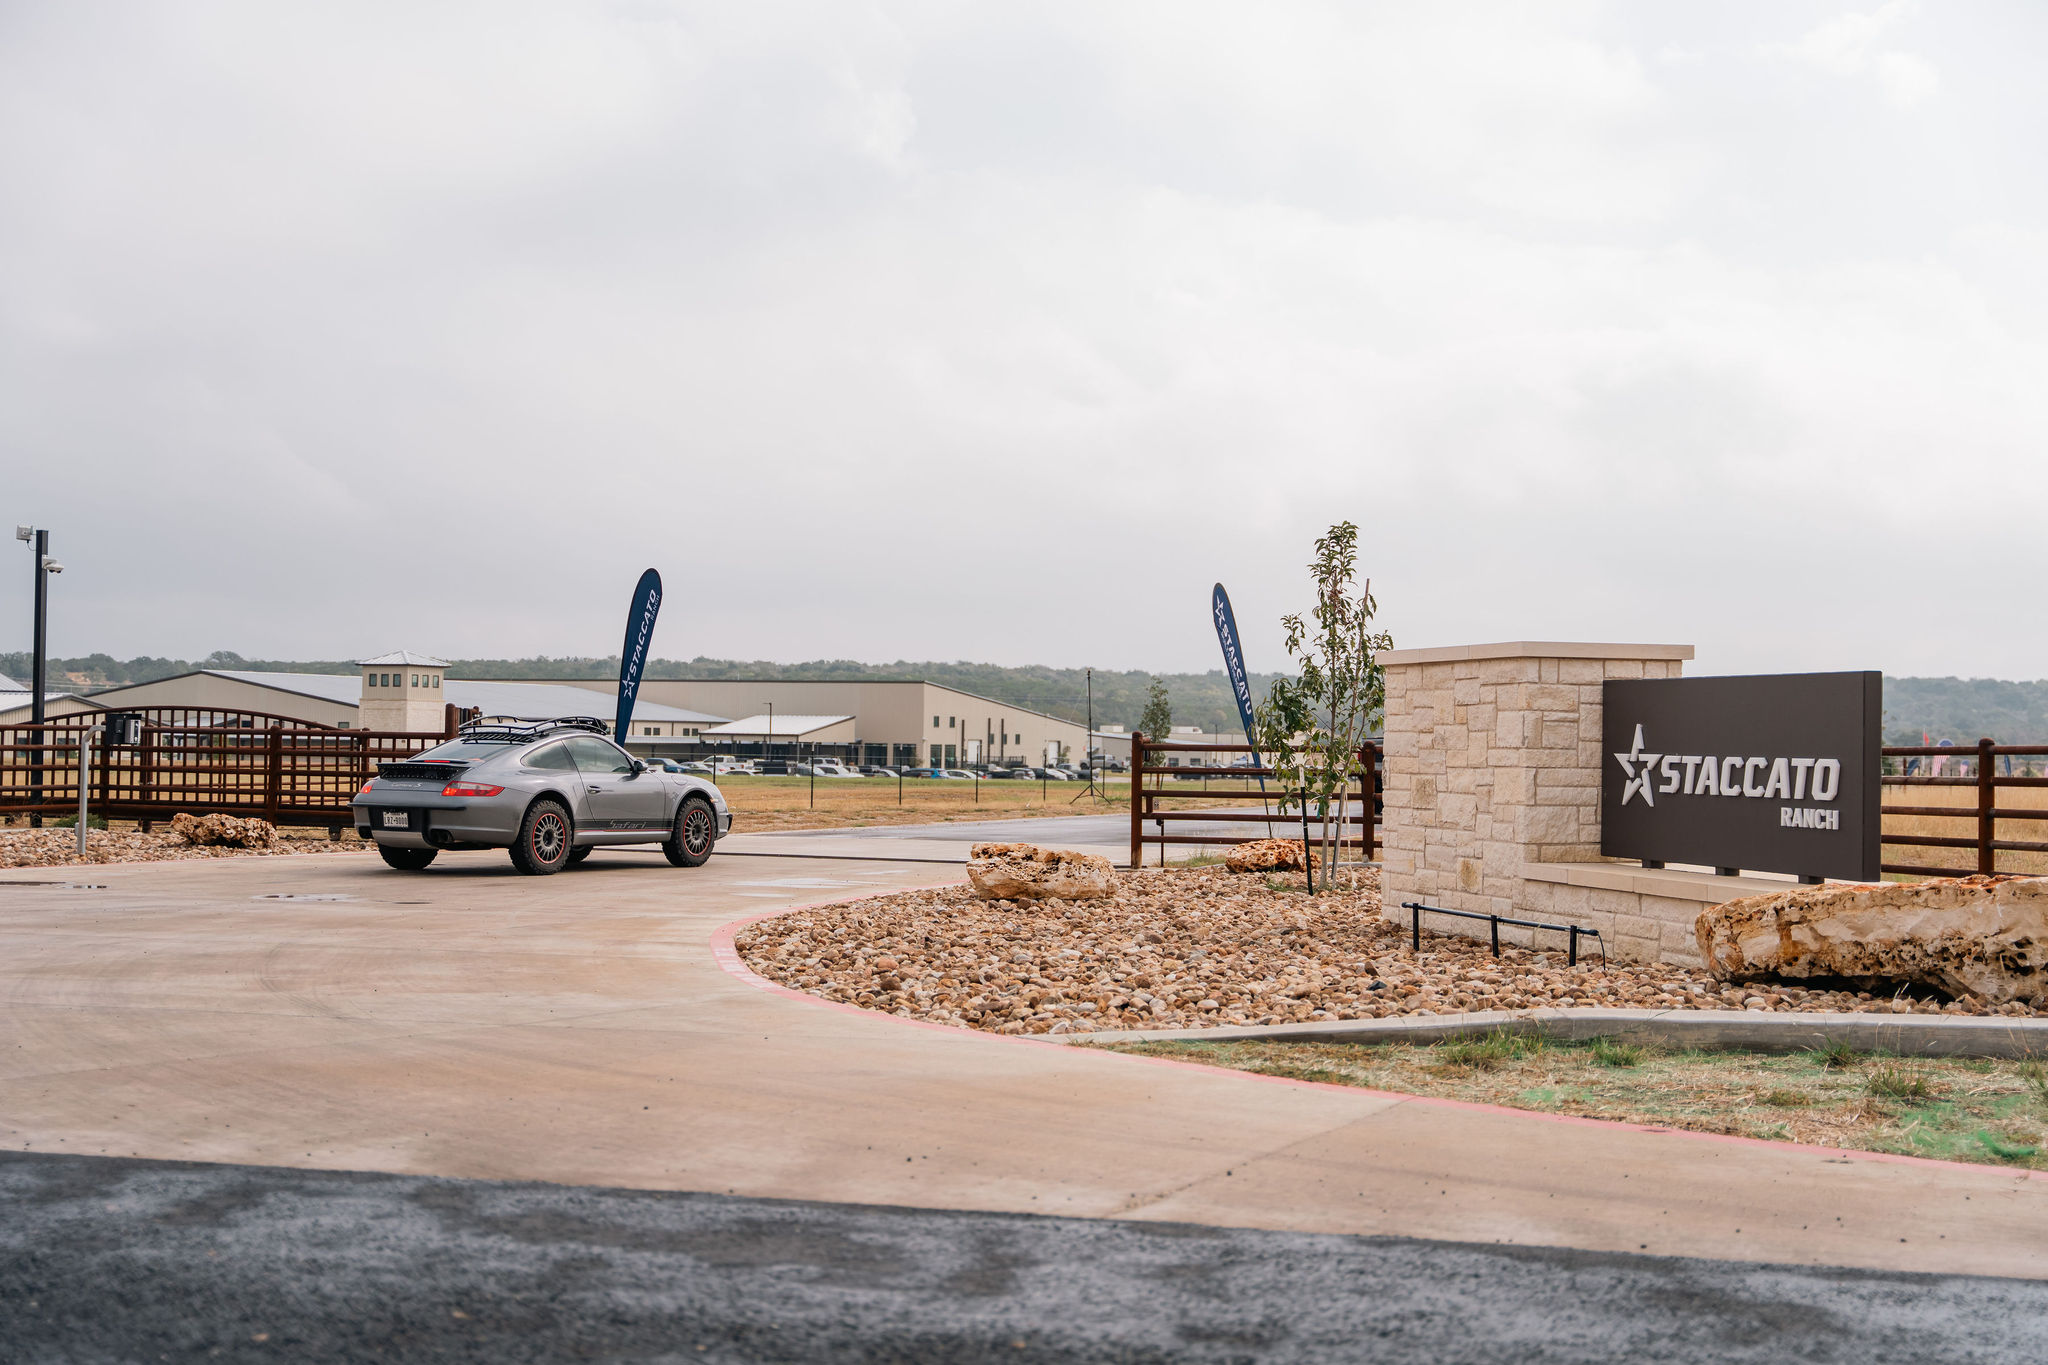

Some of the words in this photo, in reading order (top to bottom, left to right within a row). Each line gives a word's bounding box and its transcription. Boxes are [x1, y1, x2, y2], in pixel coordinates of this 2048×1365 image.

[650, 594, 660, 620] RANCH
[629, 589, 656, 676] STACCATO
[1659, 753, 1841, 801] STACCATO
[1780, 807, 1839, 830] RANCH
